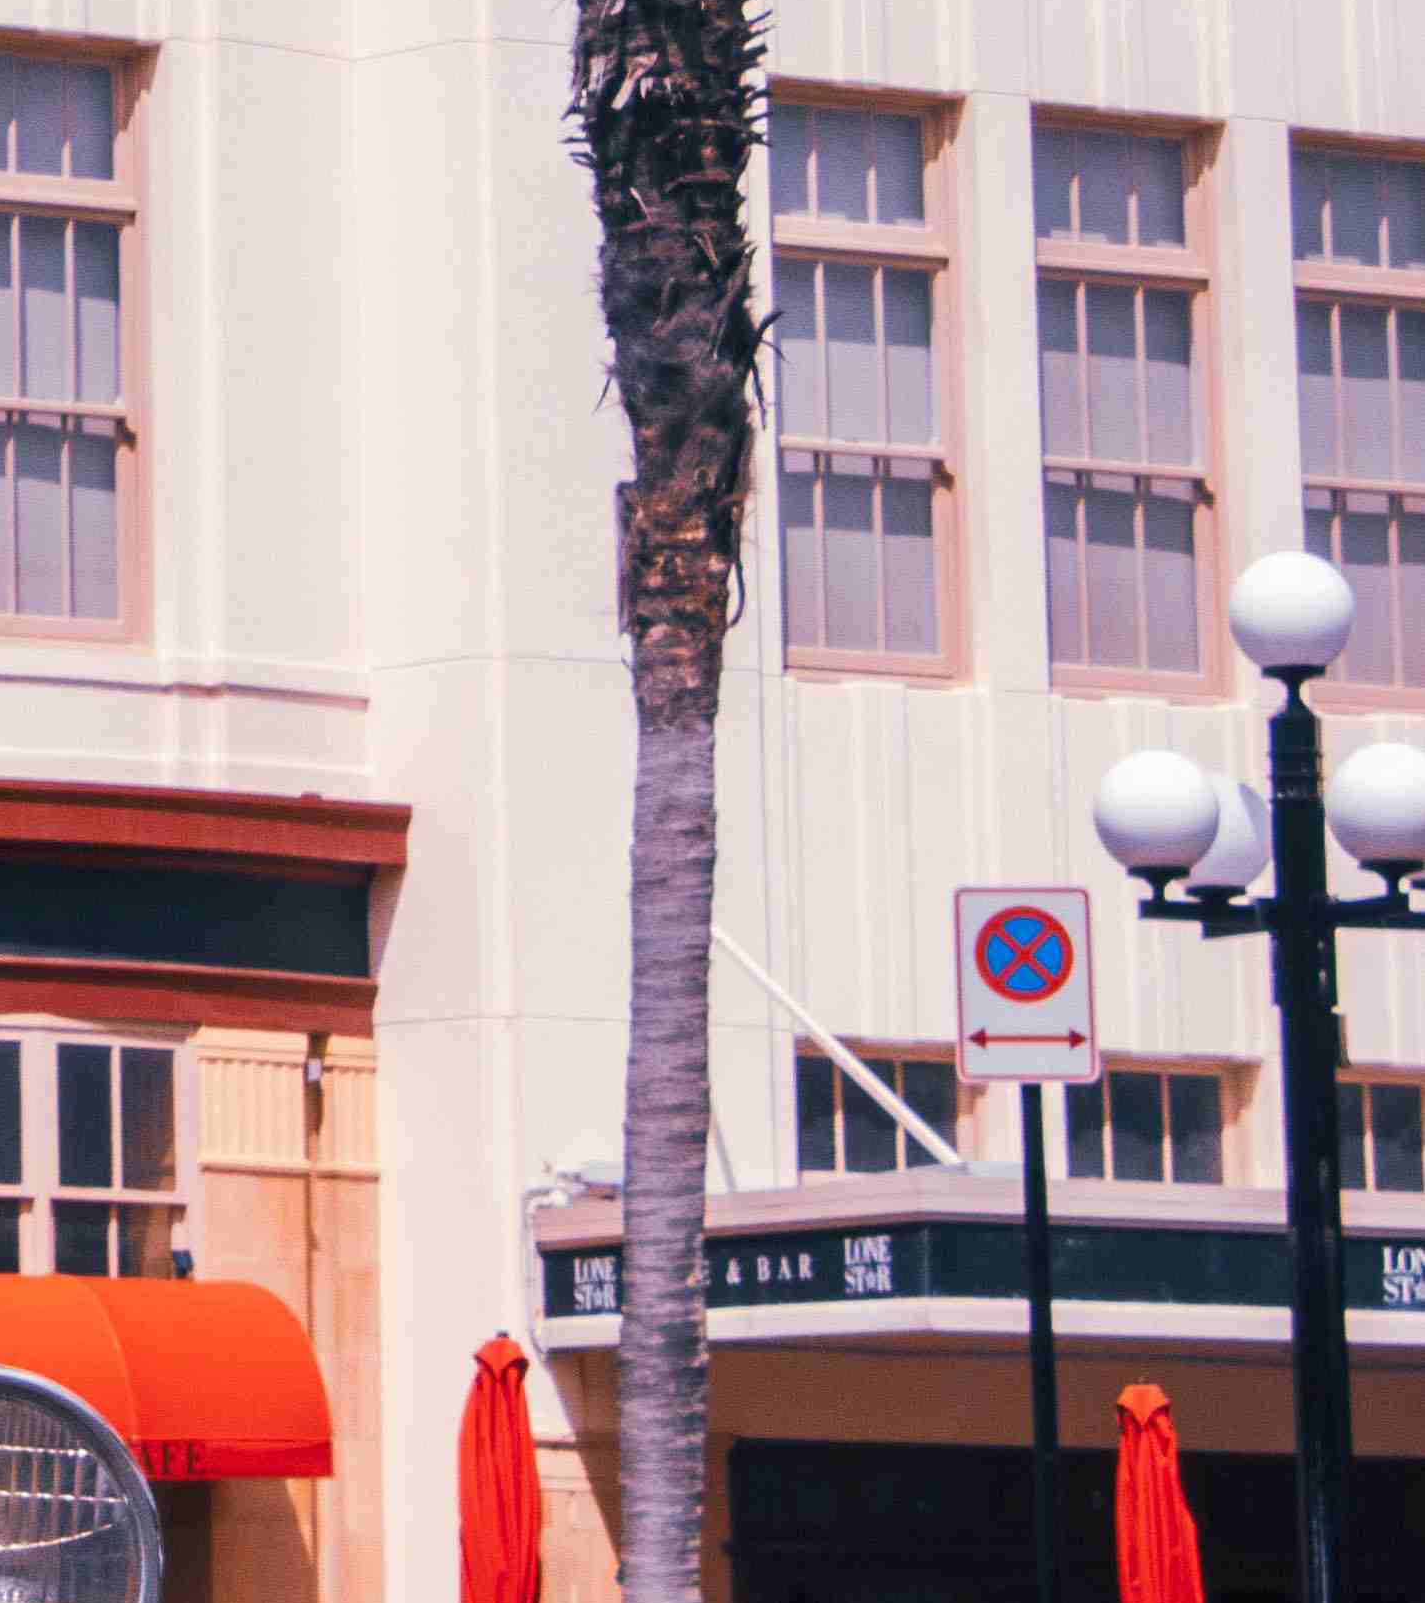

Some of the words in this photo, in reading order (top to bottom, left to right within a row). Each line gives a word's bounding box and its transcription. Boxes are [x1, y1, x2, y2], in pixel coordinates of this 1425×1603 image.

[844, 1235, 893, 1264] LONE
[574, 1256, 616, 1283] LONE
[757, 1253, 813, 1282] BAR
